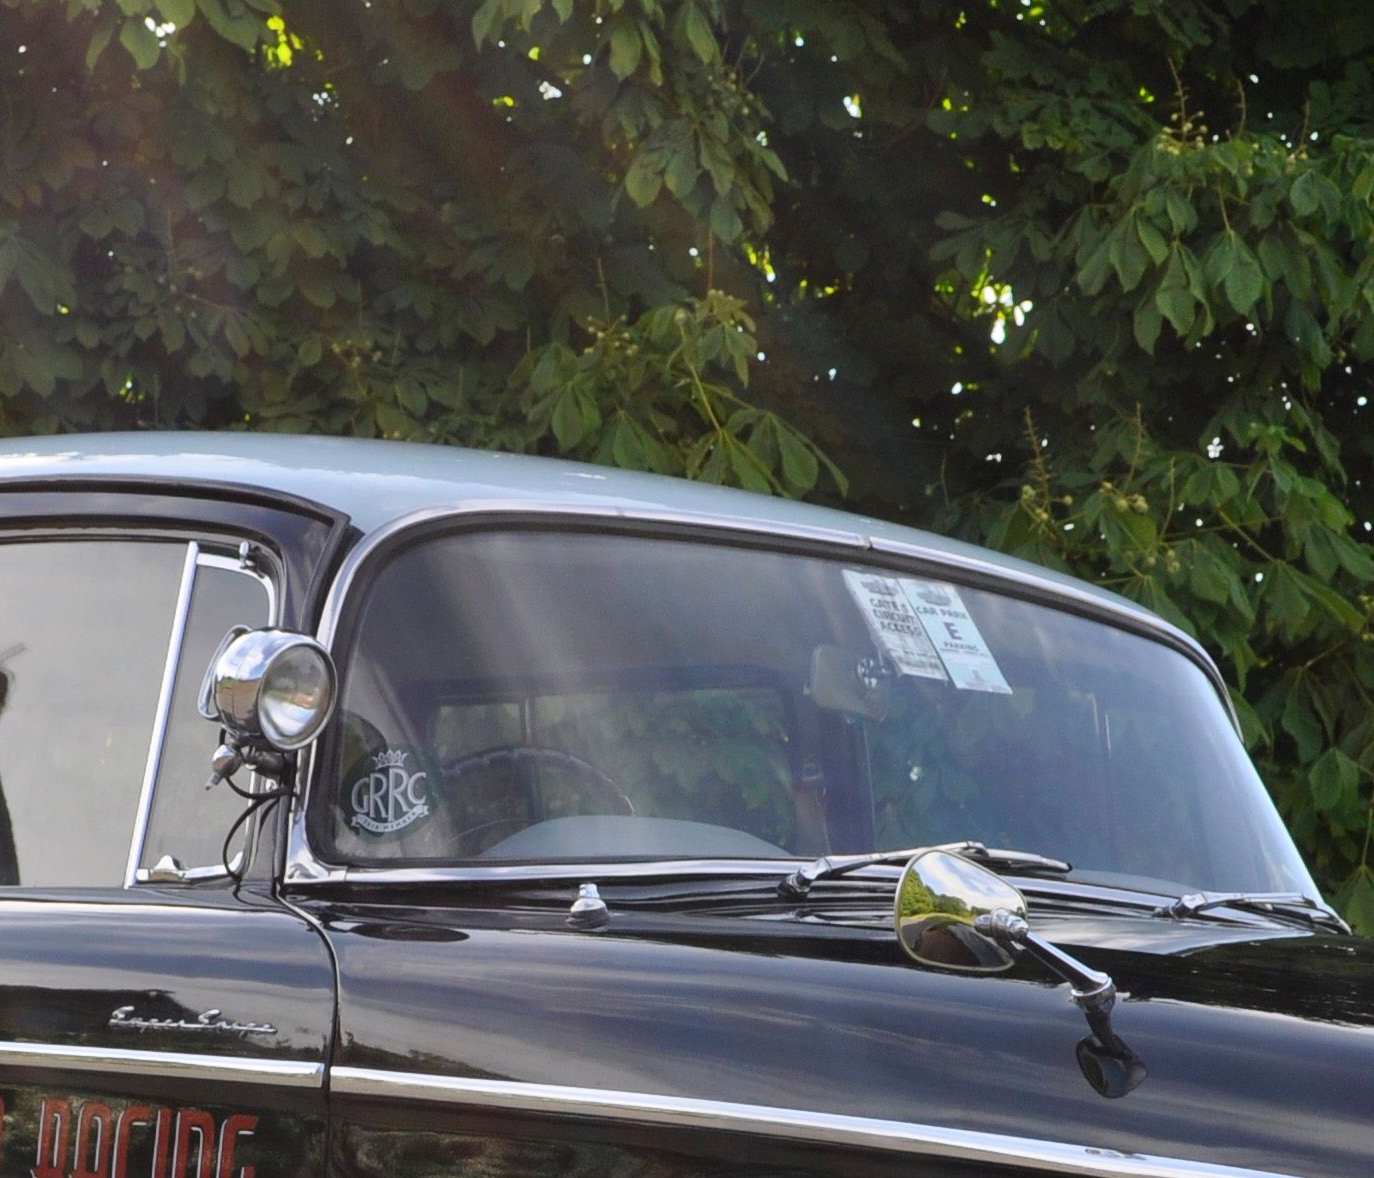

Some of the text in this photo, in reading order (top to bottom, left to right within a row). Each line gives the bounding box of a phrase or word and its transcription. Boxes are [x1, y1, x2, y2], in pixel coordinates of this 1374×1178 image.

[916, 606, 969, 620] CAR PARK
[880, 620, 922, 636] ACCESS
[943, 621, 963, 640] E
[351, 766, 427, 822] GRRC
